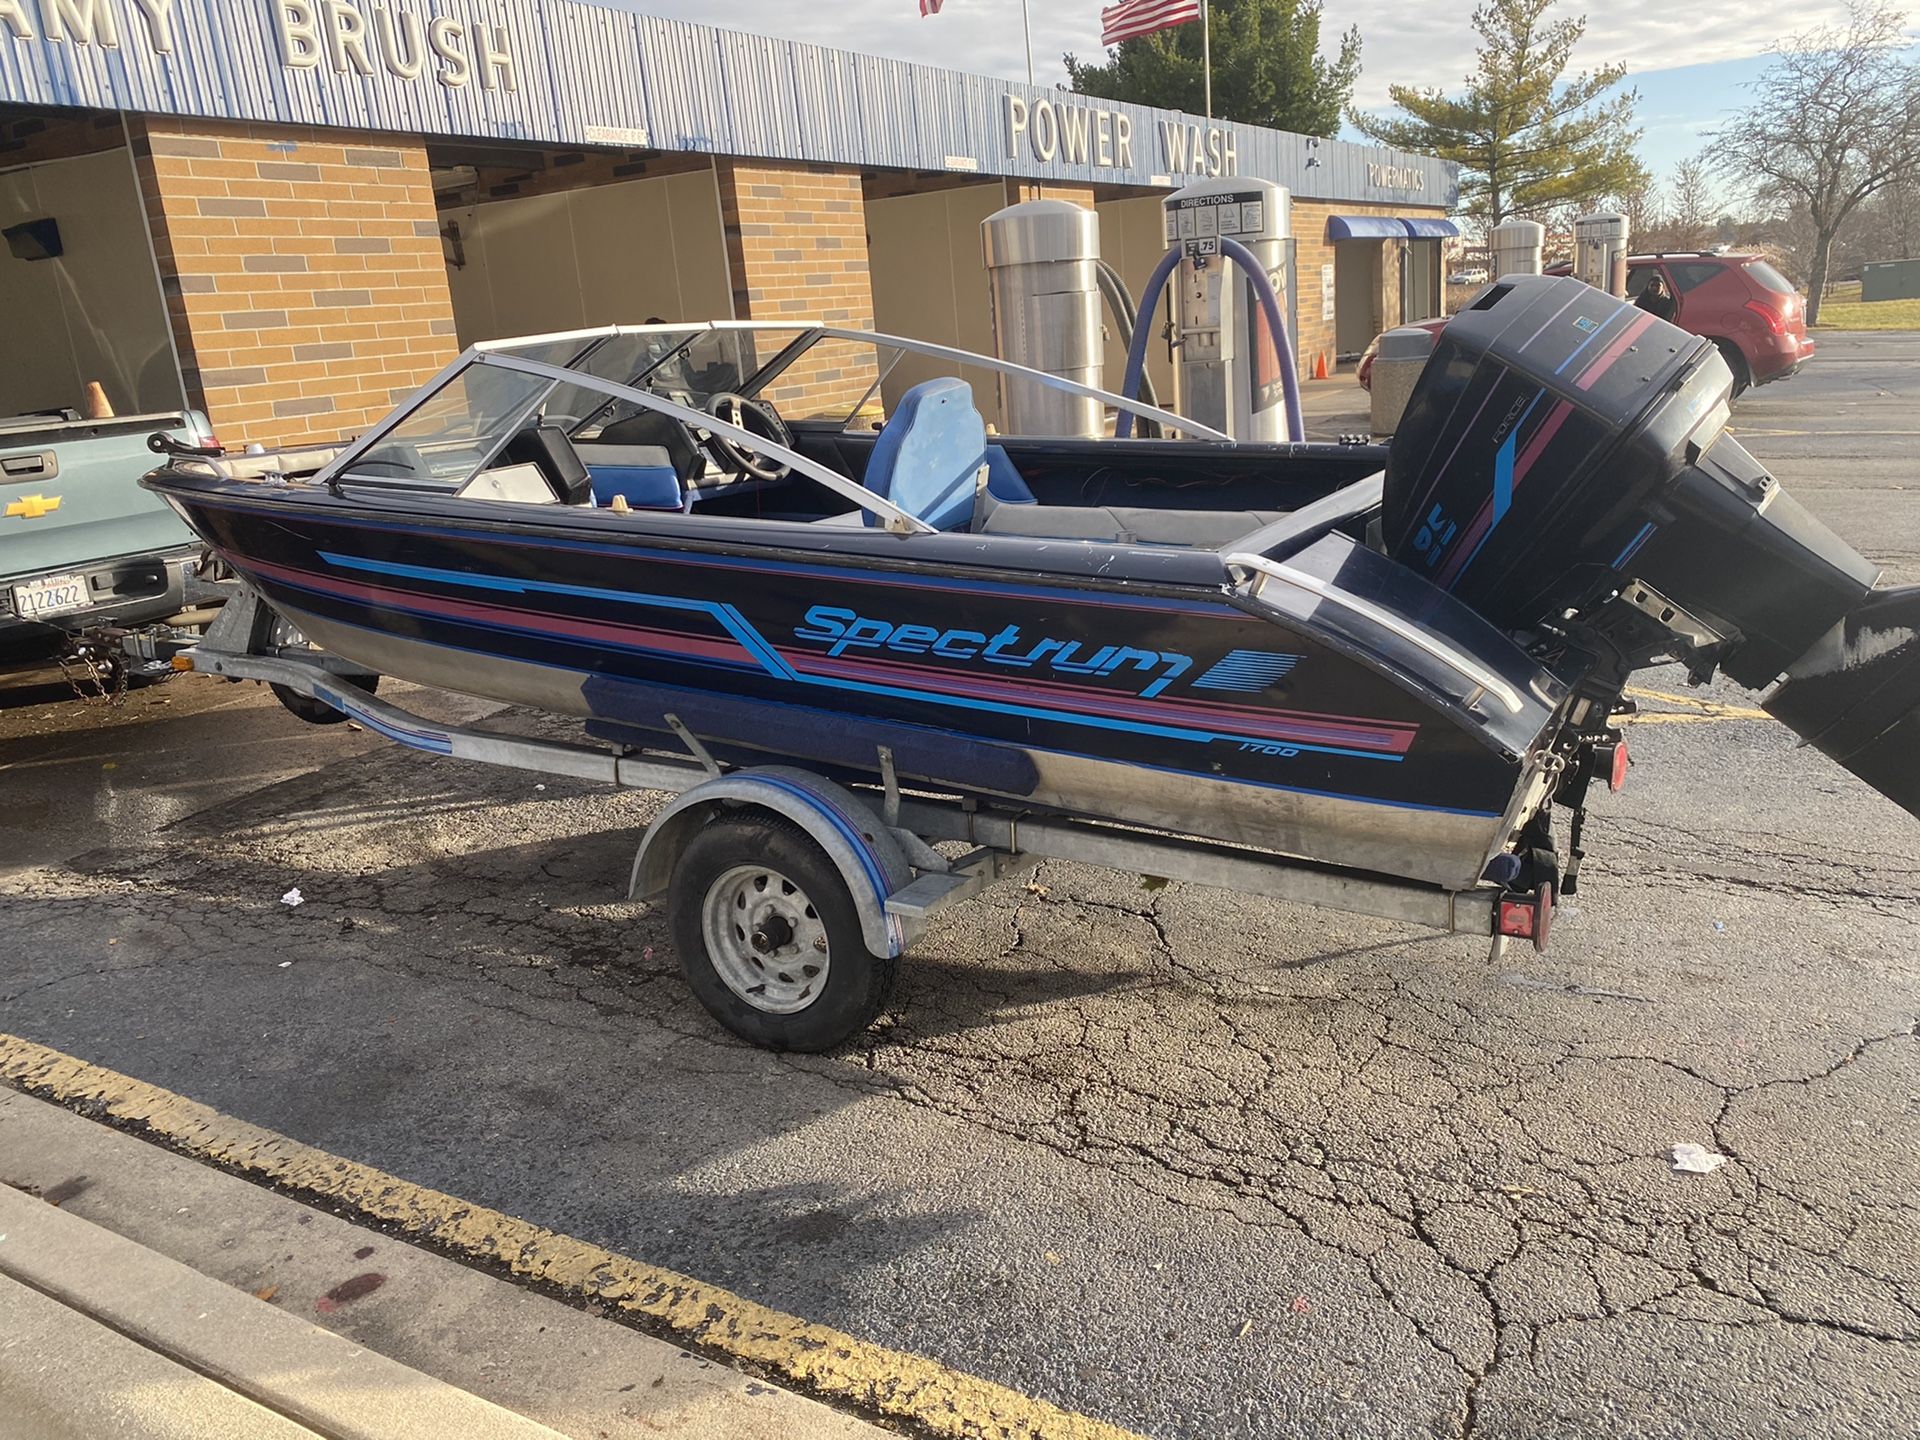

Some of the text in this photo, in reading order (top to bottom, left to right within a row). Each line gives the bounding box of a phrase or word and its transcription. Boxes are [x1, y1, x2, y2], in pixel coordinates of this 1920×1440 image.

[272, 0, 517, 94] BRUSH
[1003, 93, 1238, 178] POWER WASH
[1367, 161, 1424, 191] POWERMATICS
[1180, 194, 1234, 208] DIRECTIONS
[18, 584, 81, 613] 2122622
[793, 604, 1193, 698] Spectrum
[1238, 742, 1300, 758] 1700
